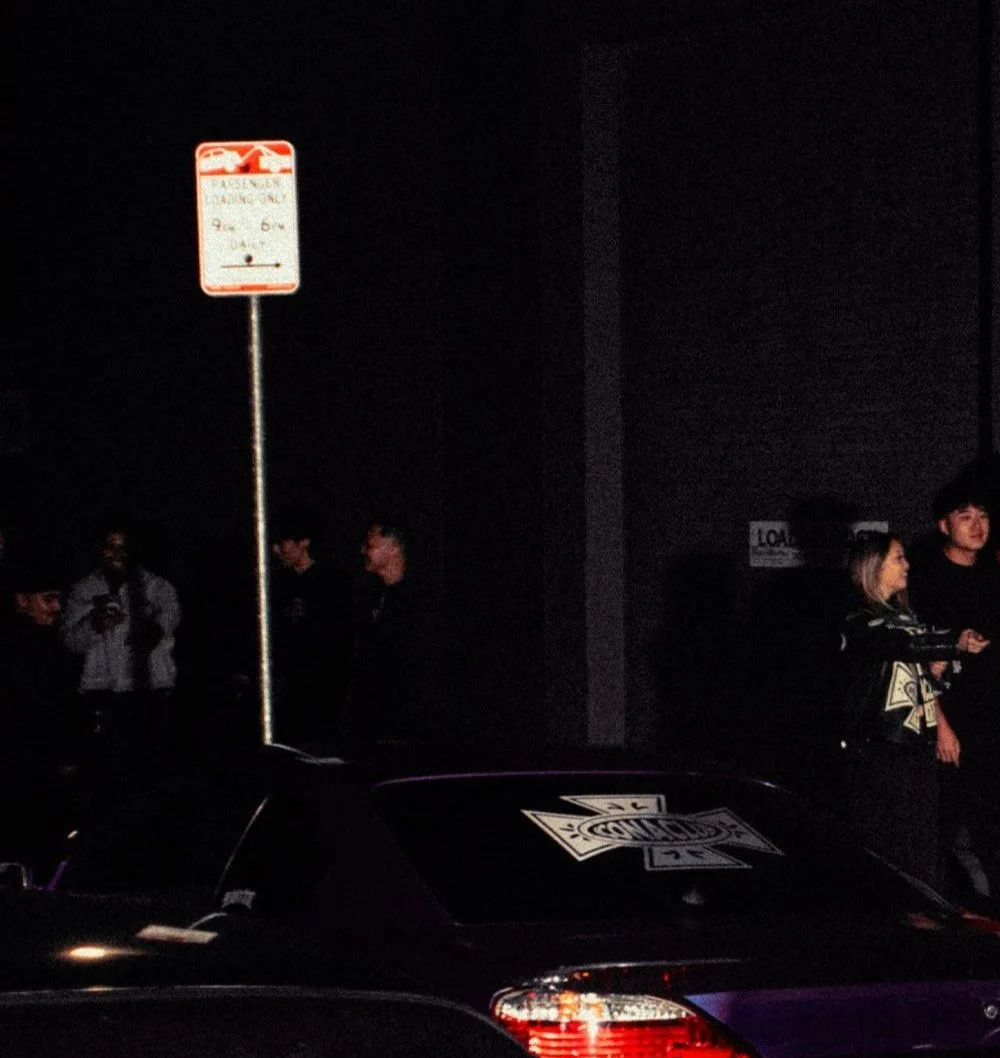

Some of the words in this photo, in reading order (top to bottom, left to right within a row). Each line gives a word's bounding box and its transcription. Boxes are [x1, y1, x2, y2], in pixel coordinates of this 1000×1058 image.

[211, 178, 281, 190] PASSENGER
[204, 193, 254, 206] LOADING
[257, 192, 287, 204] ONLY
[230, 240, 266, 251] DAILY
